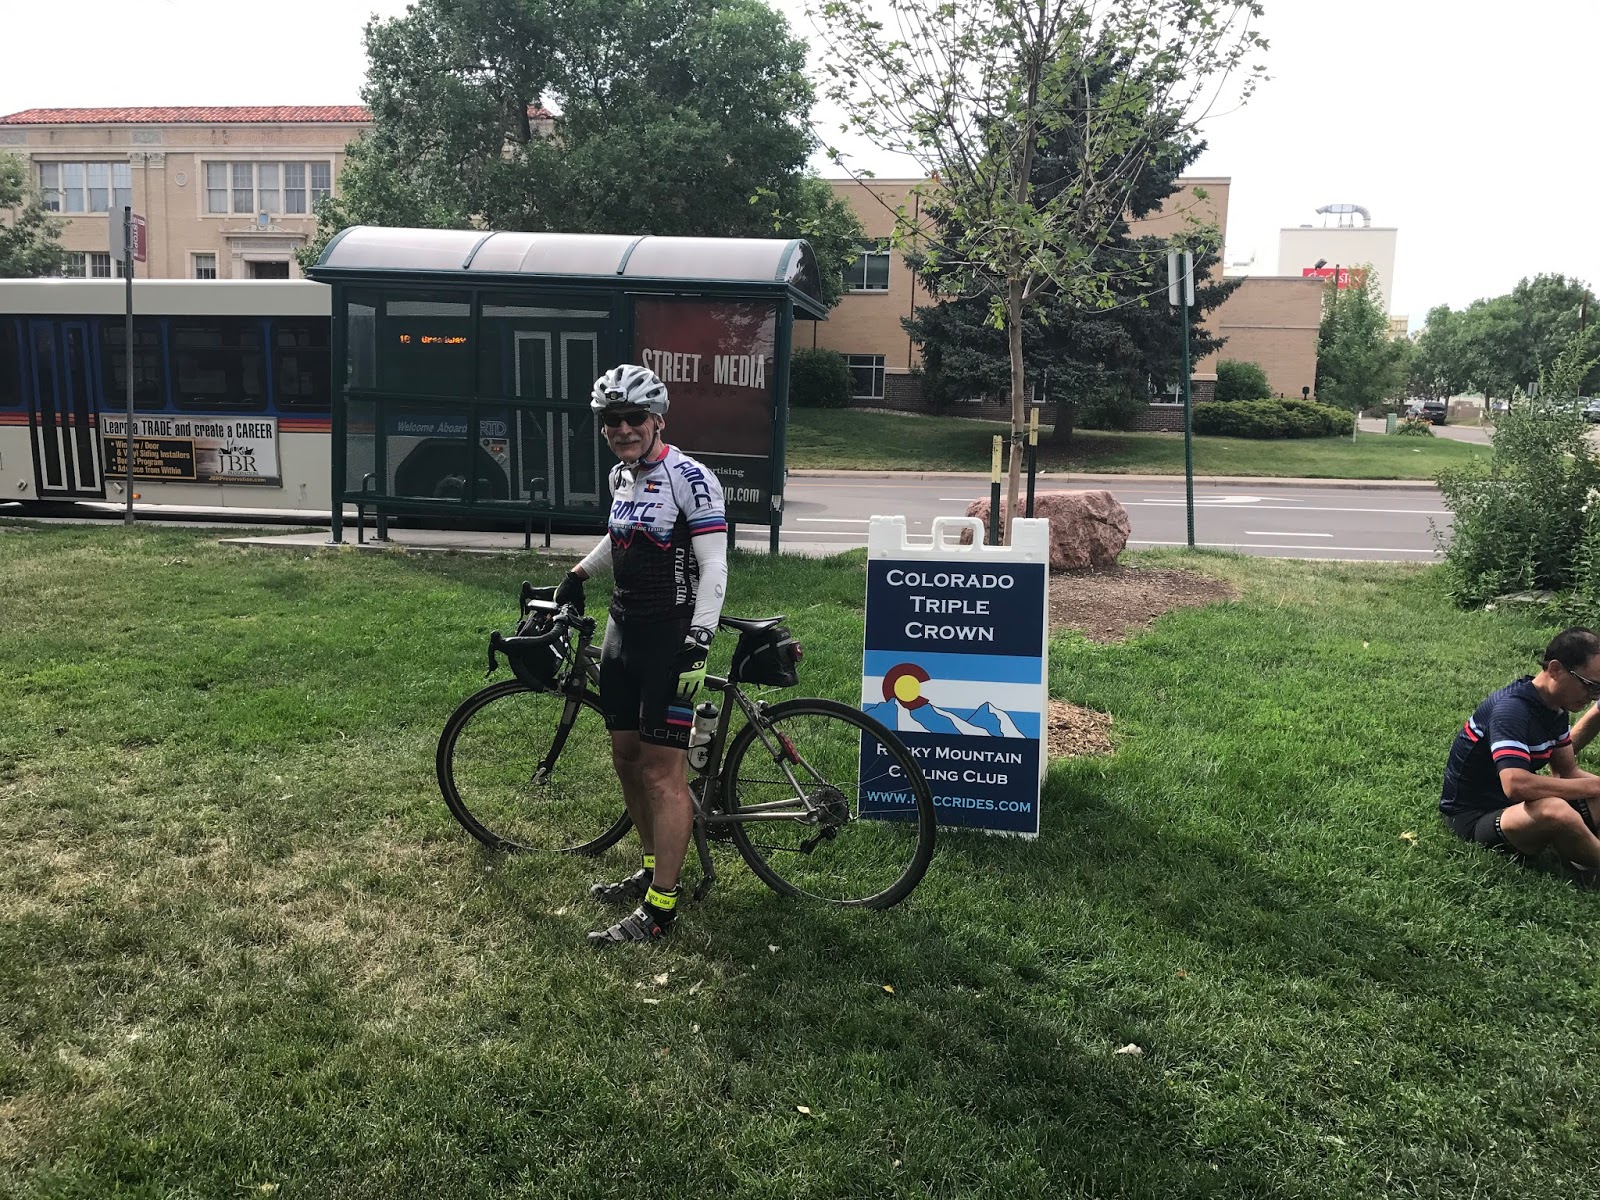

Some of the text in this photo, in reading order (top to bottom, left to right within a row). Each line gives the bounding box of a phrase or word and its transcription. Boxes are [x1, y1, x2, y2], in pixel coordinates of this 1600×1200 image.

[641, 348, 765, 389] STREET MEDIA
[141, 420, 172, 436] TRADE
[174, 422, 192, 437] and
[194, 423, 225, 438] create
[227, 425, 233, 438] a
[235, 423, 273, 439] CAREER
[398, 421, 468, 433] Welcome Aboard
[480, 420, 507, 436] RTD
[115, 440, 140, 449] Winw
[144, 442, 160, 450] Door
[122, 448, 139, 457] Vyl
[139, 449, 159, 459] Siding
[160, 450, 190, 459] Installers
[116, 456, 164, 466] Bons Program
[117, 464, 182, 475] Adnce from Within
[216, 455, 257, 474] JBR
[710, 467, 745, 478] rtising
[611, 500, 656, 522] RMCC
[886, 569, 1015, 589] COLORADO
[909, 595, 990, 615] TRIPLE
[904, 621, 995, 641] CROWN
[640, 725, 690, 743] LCHE
[876, 743, 1022, 764] RKY MOUNTAIN
[889, 765, 1008, 785] CLING CLUB
[867, 790, 1031, 813] WWW.CCRIDES.COM
